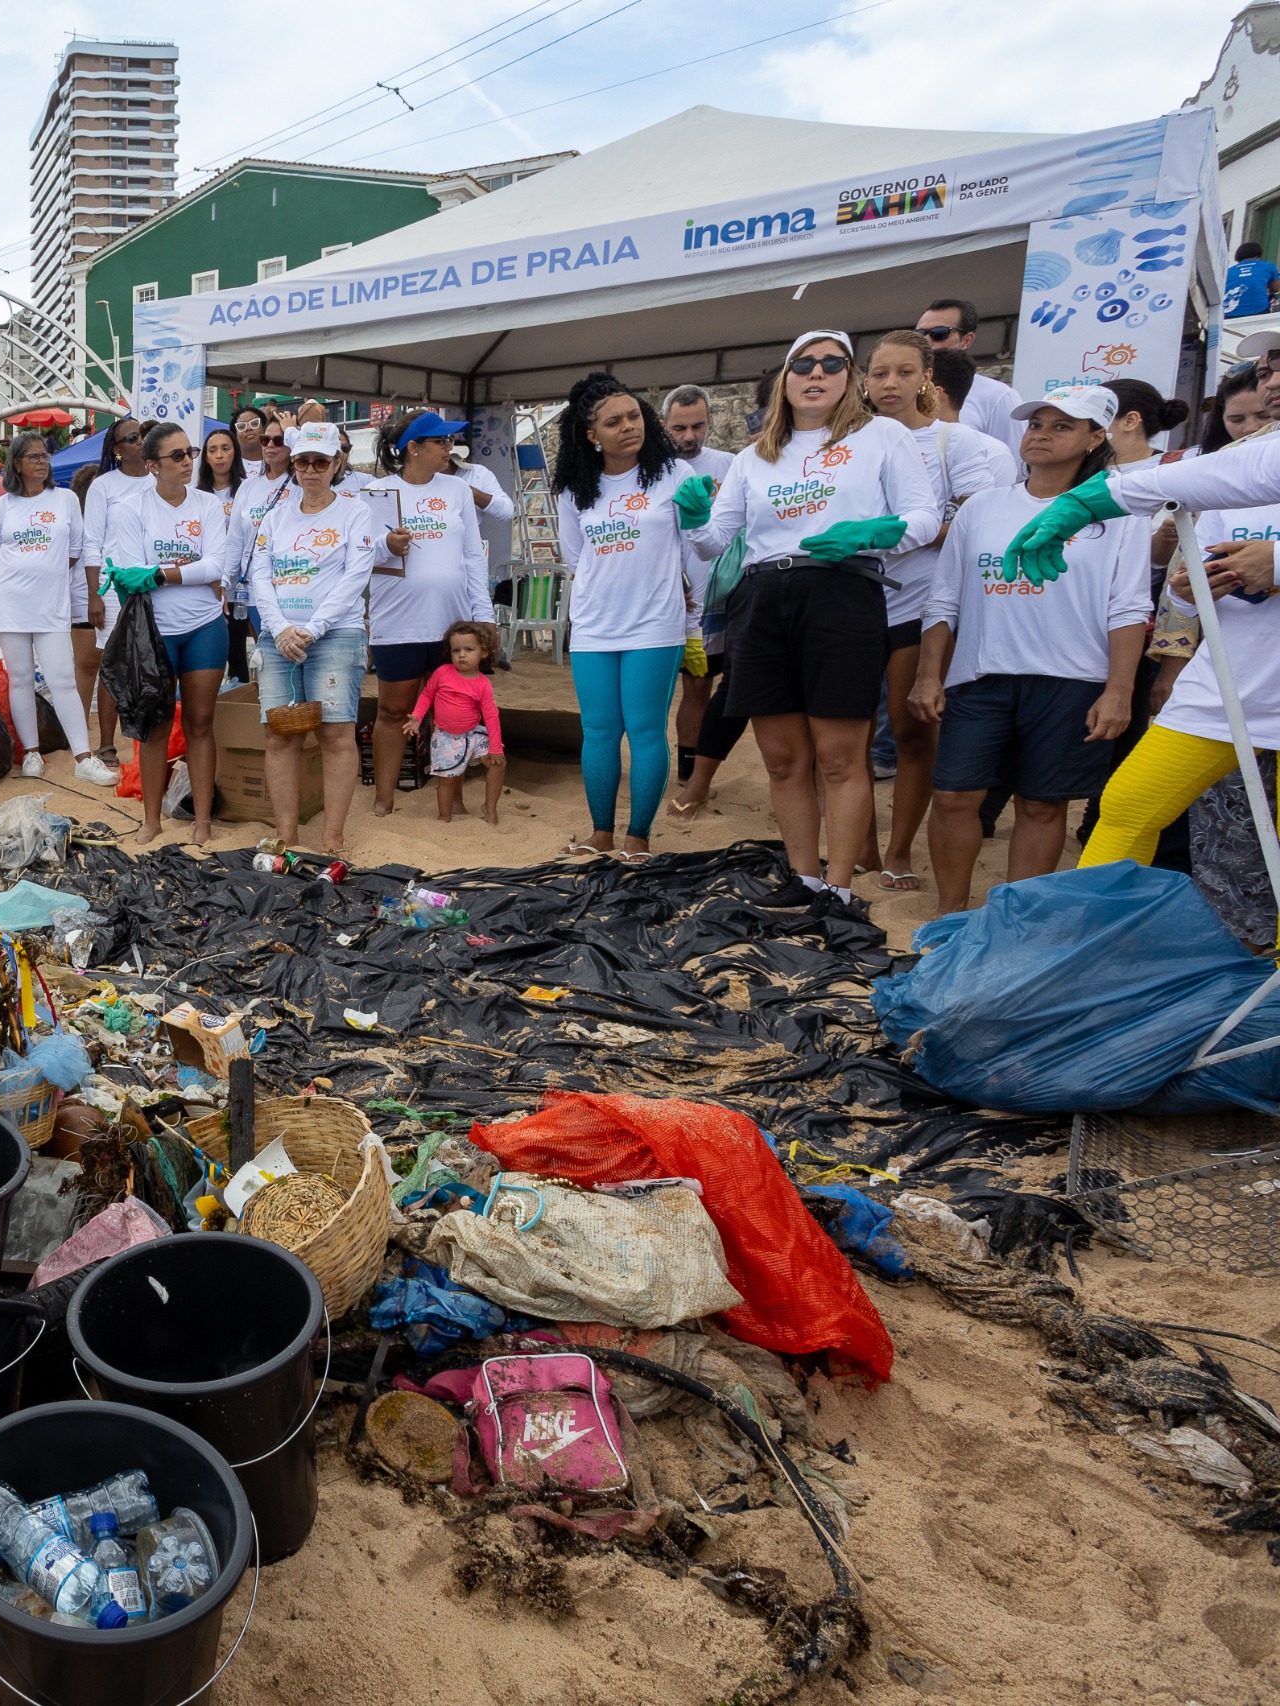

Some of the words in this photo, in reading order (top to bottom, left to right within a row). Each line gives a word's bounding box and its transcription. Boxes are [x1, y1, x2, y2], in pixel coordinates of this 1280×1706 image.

[839, 178, 919, 203] GOVERNO
[923, 173, 947, 188] DA
[959, 192, 974, 201] DA
[975, 185, 1009, 198] GENTE
[960, 182, 977, 192] DO
[979, 176, 1009, 189] LADO
[836, 185, 947, 225] BAHIA
[683, 207, 817, 251] inema
[839, 223, 877, 235] SECRETARIA
[877, 221, 887, 229] DO
[888, 218, 905, 227] MEIO
[905, 213, 940, 225] AMBIENTE
[709, 248, 718, 256] DO
[718, 246, 731, 254] MEIO
[731, 241, 758, 252] AMBIENTE
[761, 236, 789, 247] RECURSOS
[209, 294, 281, 327] AÇÃO
[287, 287, 326, 314] DE
[331, 265, 463, 308] LIMPEZA
[471, 255, 518, 286] DE
[526, 235, 641, 277] PRAIA
[767, 479, 820, 498] Bahia
[771, 483, 836, 508] +verde
[776, 500, 828, 520] verão
[13, 528, 42, 541] Bahia
[409, 530, 443, 541] verão
[584, 519, 625, 538] Bahia
[590, 526, 640, 546] +verde
[18, 534, 52, 545] +verde
[20, 543, 48, 552] verão
[154, 540, 190, 552] Bahia
[594, 541, 635, 556] verão
[158, 549, 200, 560] +verde
[984, 580, 1045, 595] verão
[523, 1410, 576, 1442] NIKE
